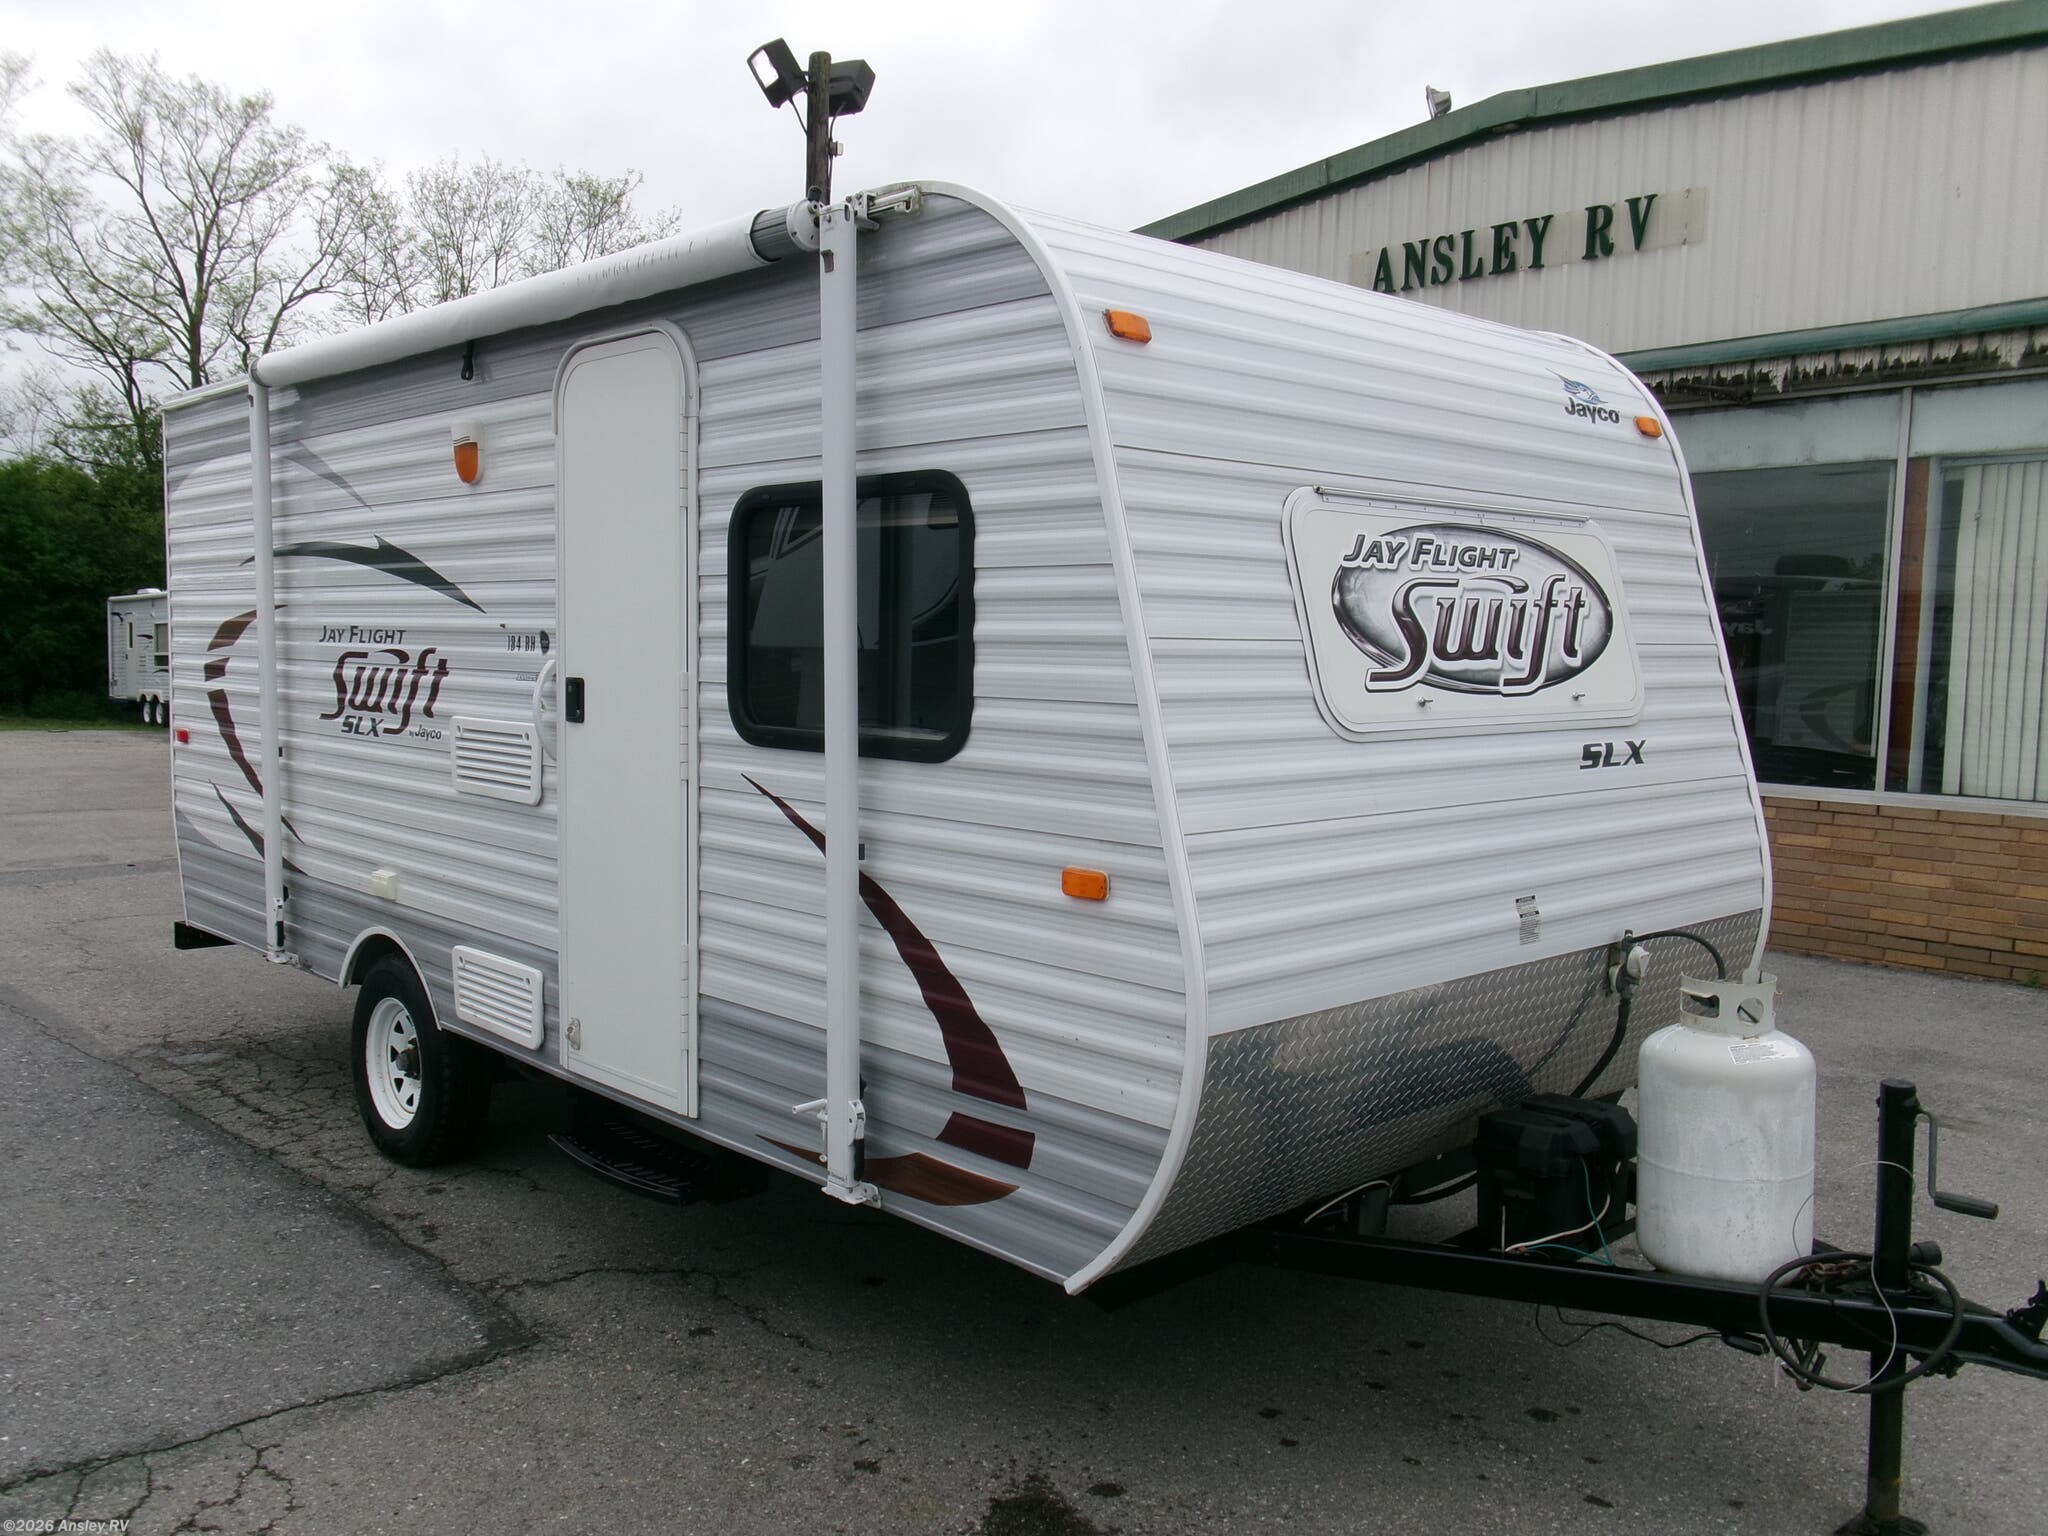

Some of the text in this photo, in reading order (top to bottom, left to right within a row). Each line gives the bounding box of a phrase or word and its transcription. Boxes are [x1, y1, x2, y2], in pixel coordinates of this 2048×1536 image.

[1373, 194, 1658, 293] ANSLEY RV
[1564, 397, 1620, 424] Jayco
[1343, 534, 1516, 569] JAY FLIGHT
[319, 625, 406, 645] JAY FLIGHT
[525, 635, 536, 652] BH
[1368, 573, 1586, 688] Swift
[319, 647, 450, 735] Swift
[341, 715, 384, 737] SLX
[415, 724, 442, 741] Jayco
[1580, 740, 1646, 770] SLX
